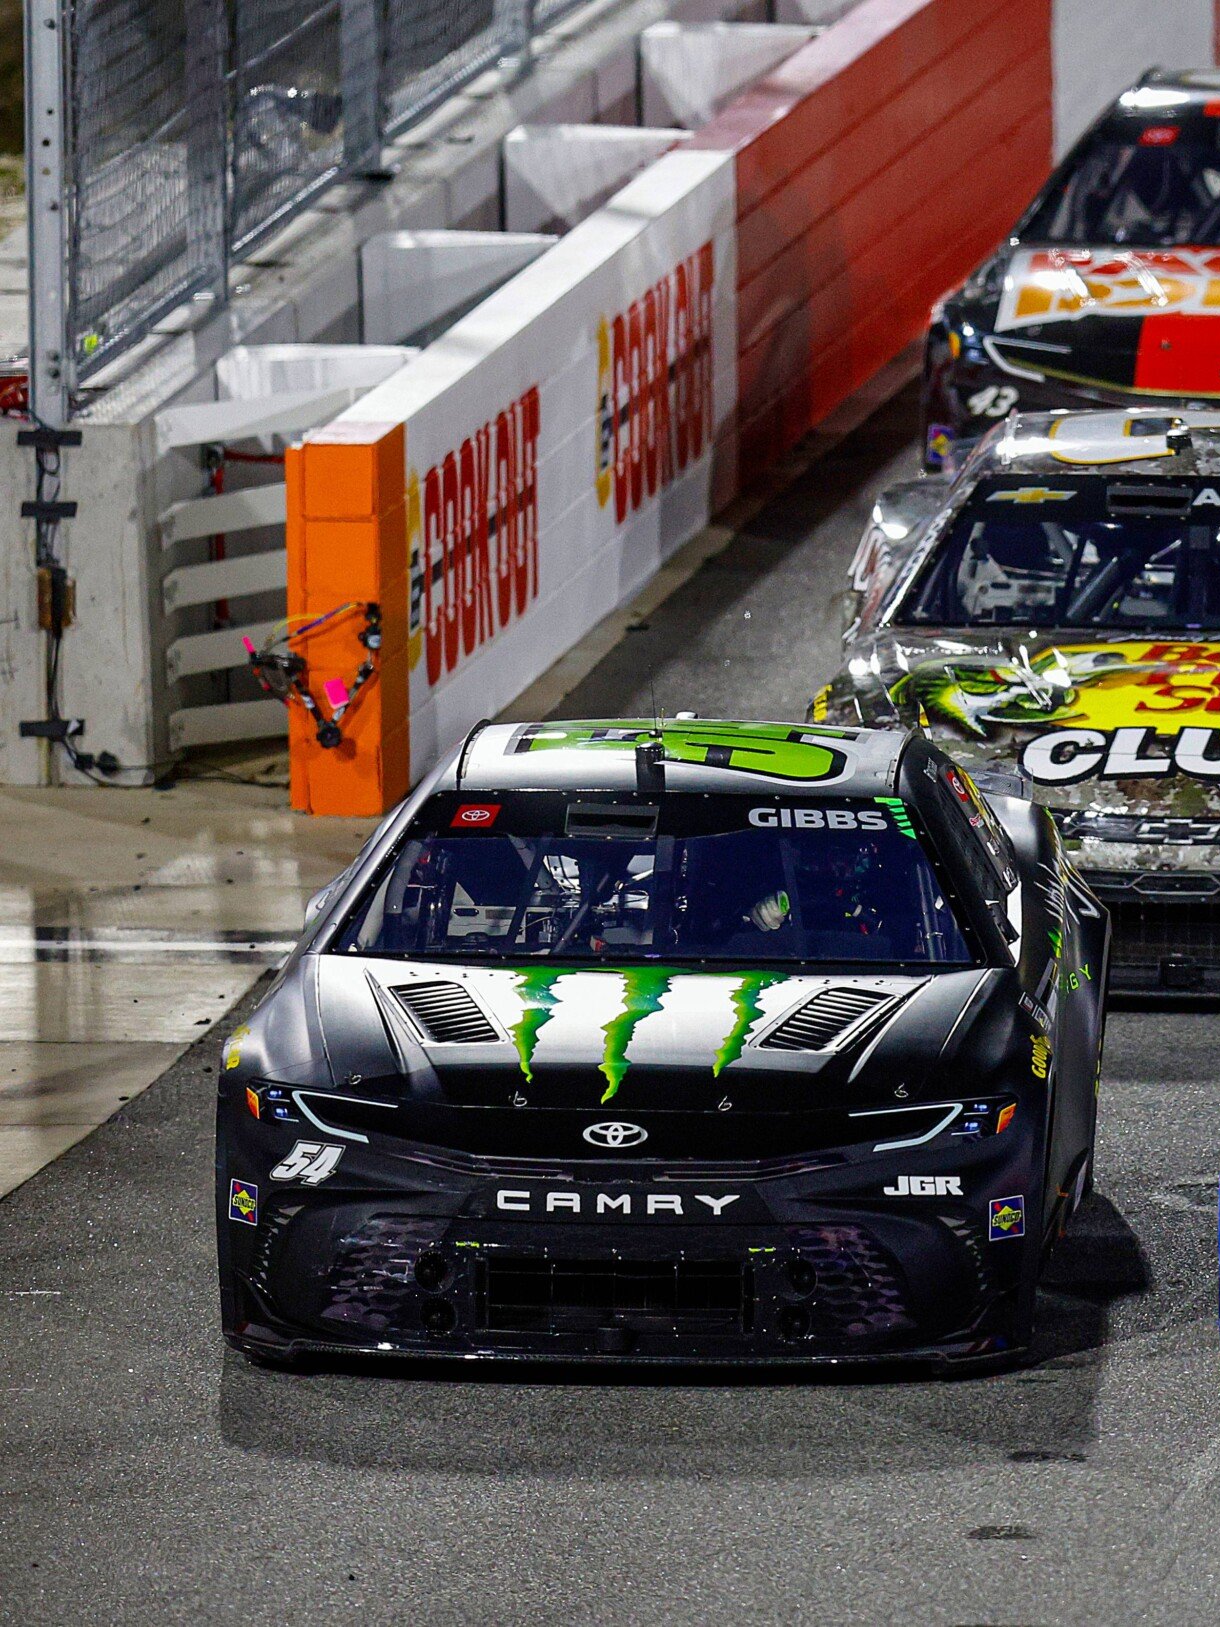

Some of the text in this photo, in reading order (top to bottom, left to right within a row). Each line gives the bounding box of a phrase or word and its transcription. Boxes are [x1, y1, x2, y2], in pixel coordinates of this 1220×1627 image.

[967, 386, 1020, 417] 43
[747, 807, 889, 831] GIBBS
[269, 1139, 347, 1187] 54
[882, 1175, 965, 1196] JGR
[495, 1189, 741, 1216] CAMRY
